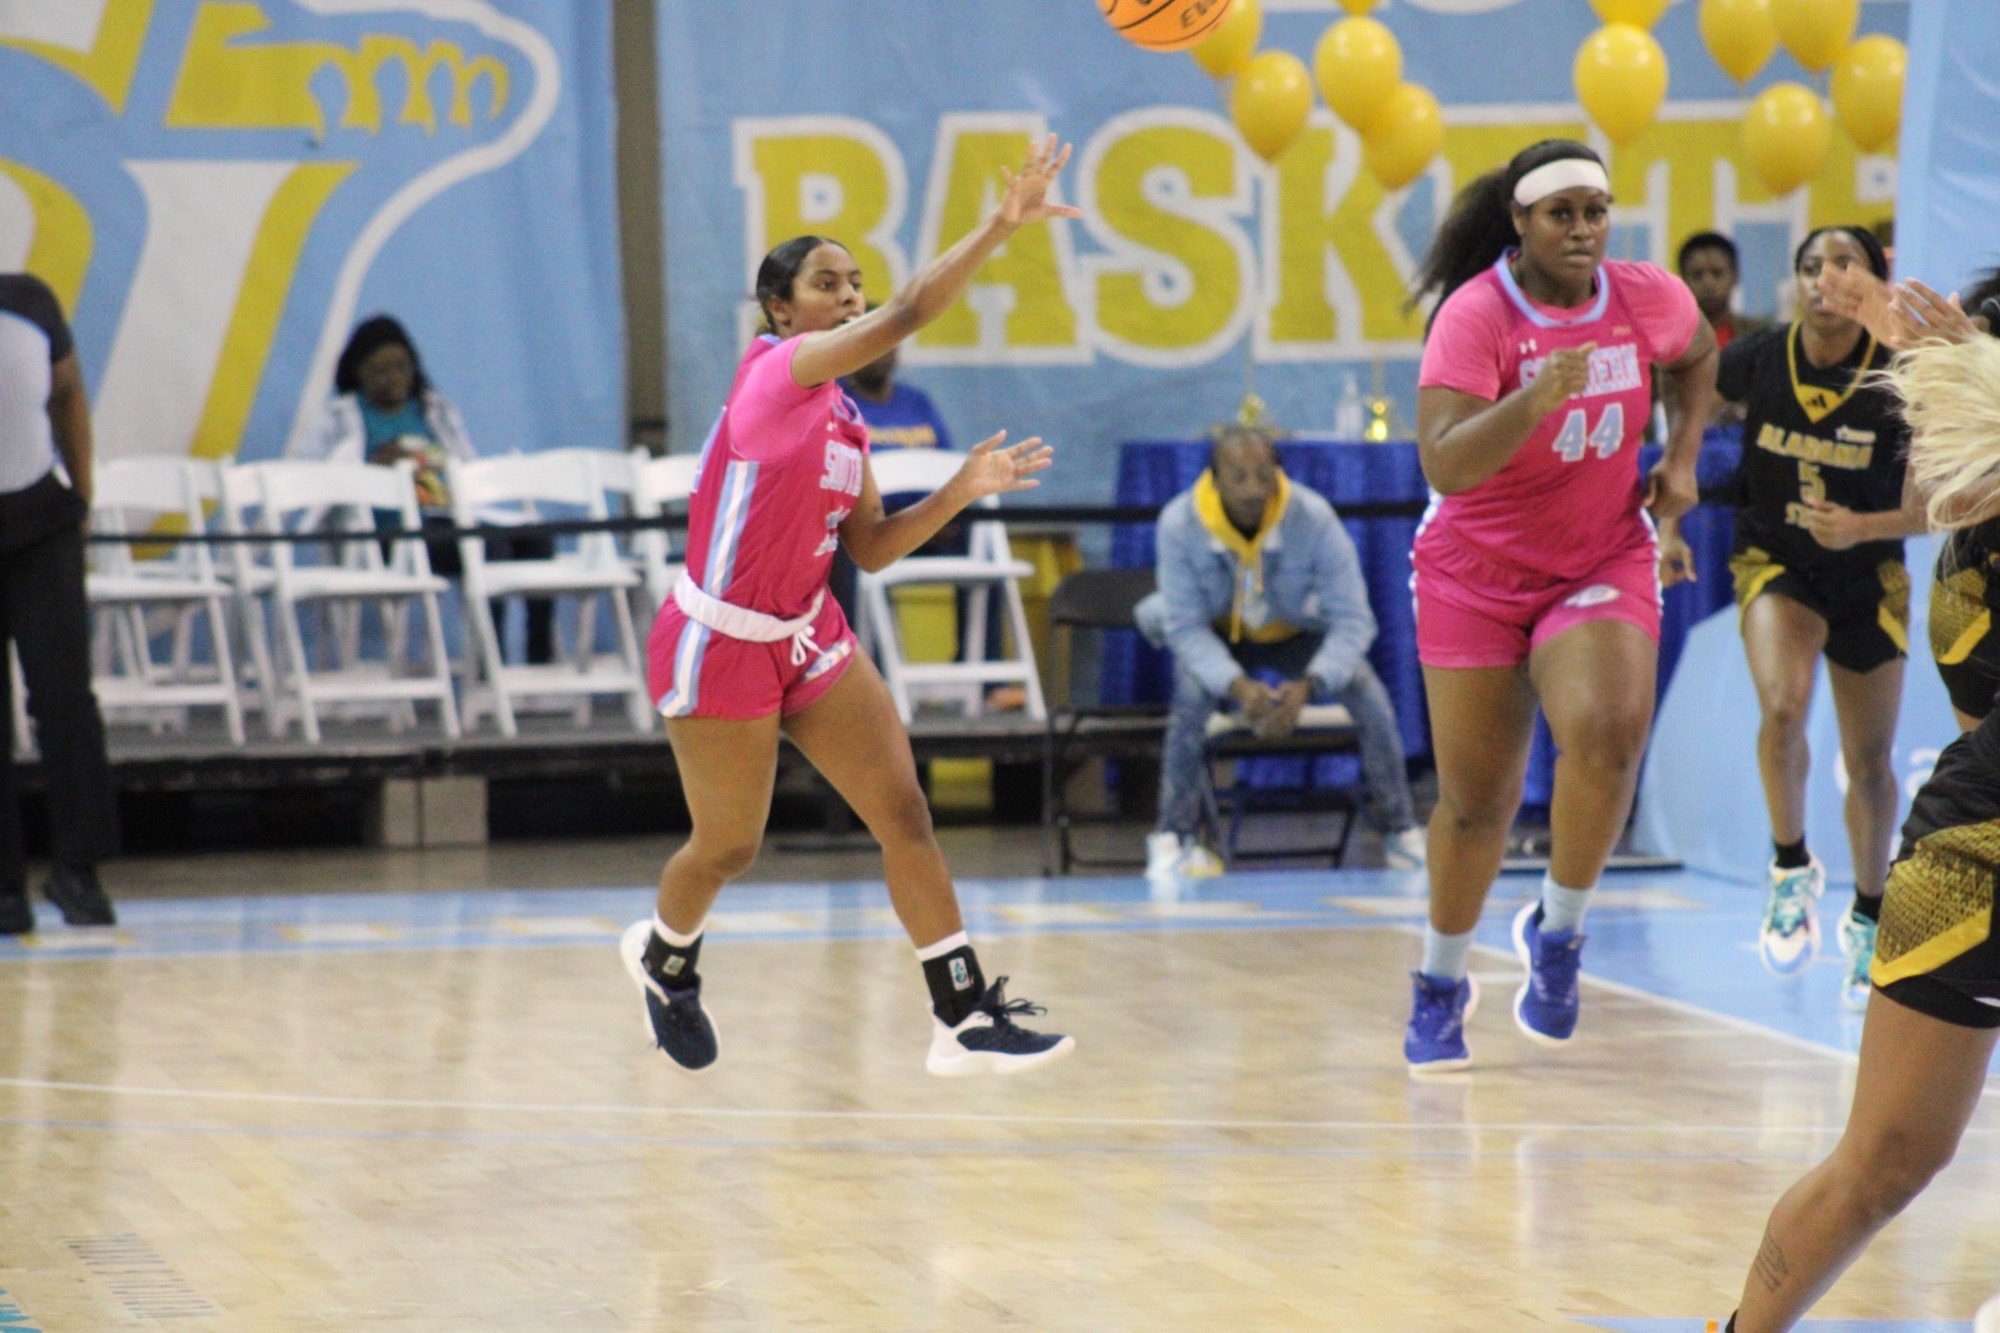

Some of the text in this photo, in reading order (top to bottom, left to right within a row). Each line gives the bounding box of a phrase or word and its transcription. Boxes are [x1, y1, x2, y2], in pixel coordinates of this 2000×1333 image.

[1552, 402, 1625, 463] 44
[1756, 422, 1874, 470] ALABAMA
[1798, 459, 1826, 504] 5
